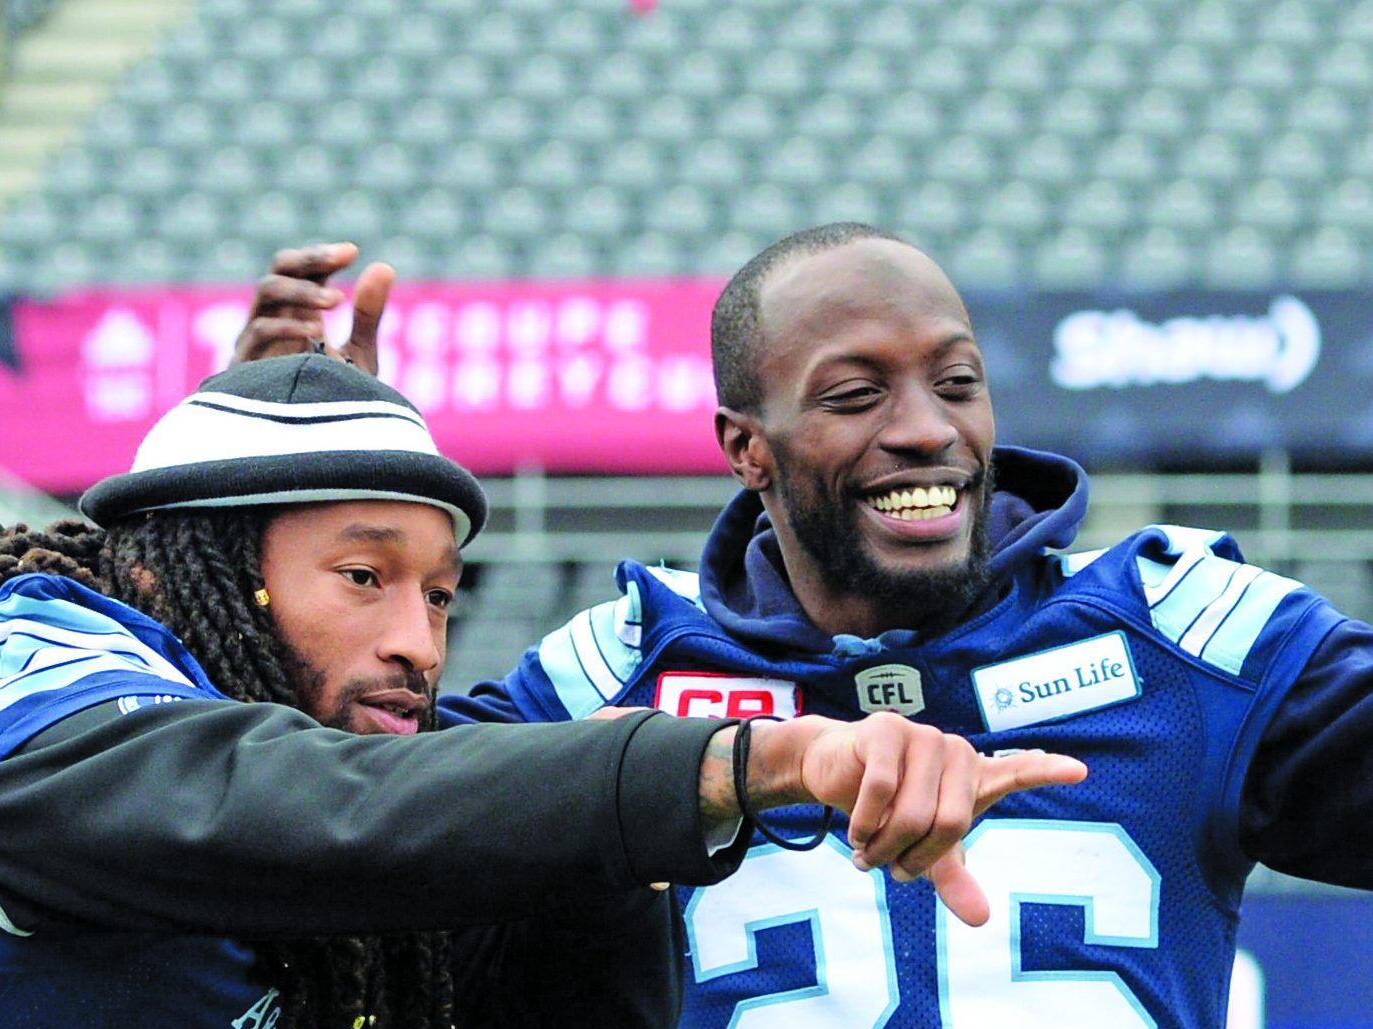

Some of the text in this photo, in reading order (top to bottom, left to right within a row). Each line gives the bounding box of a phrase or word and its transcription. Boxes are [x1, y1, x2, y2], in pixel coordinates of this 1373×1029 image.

[866, 682, 913, 705] CFL
[1018, 657, 1126, 703] Sun Life
